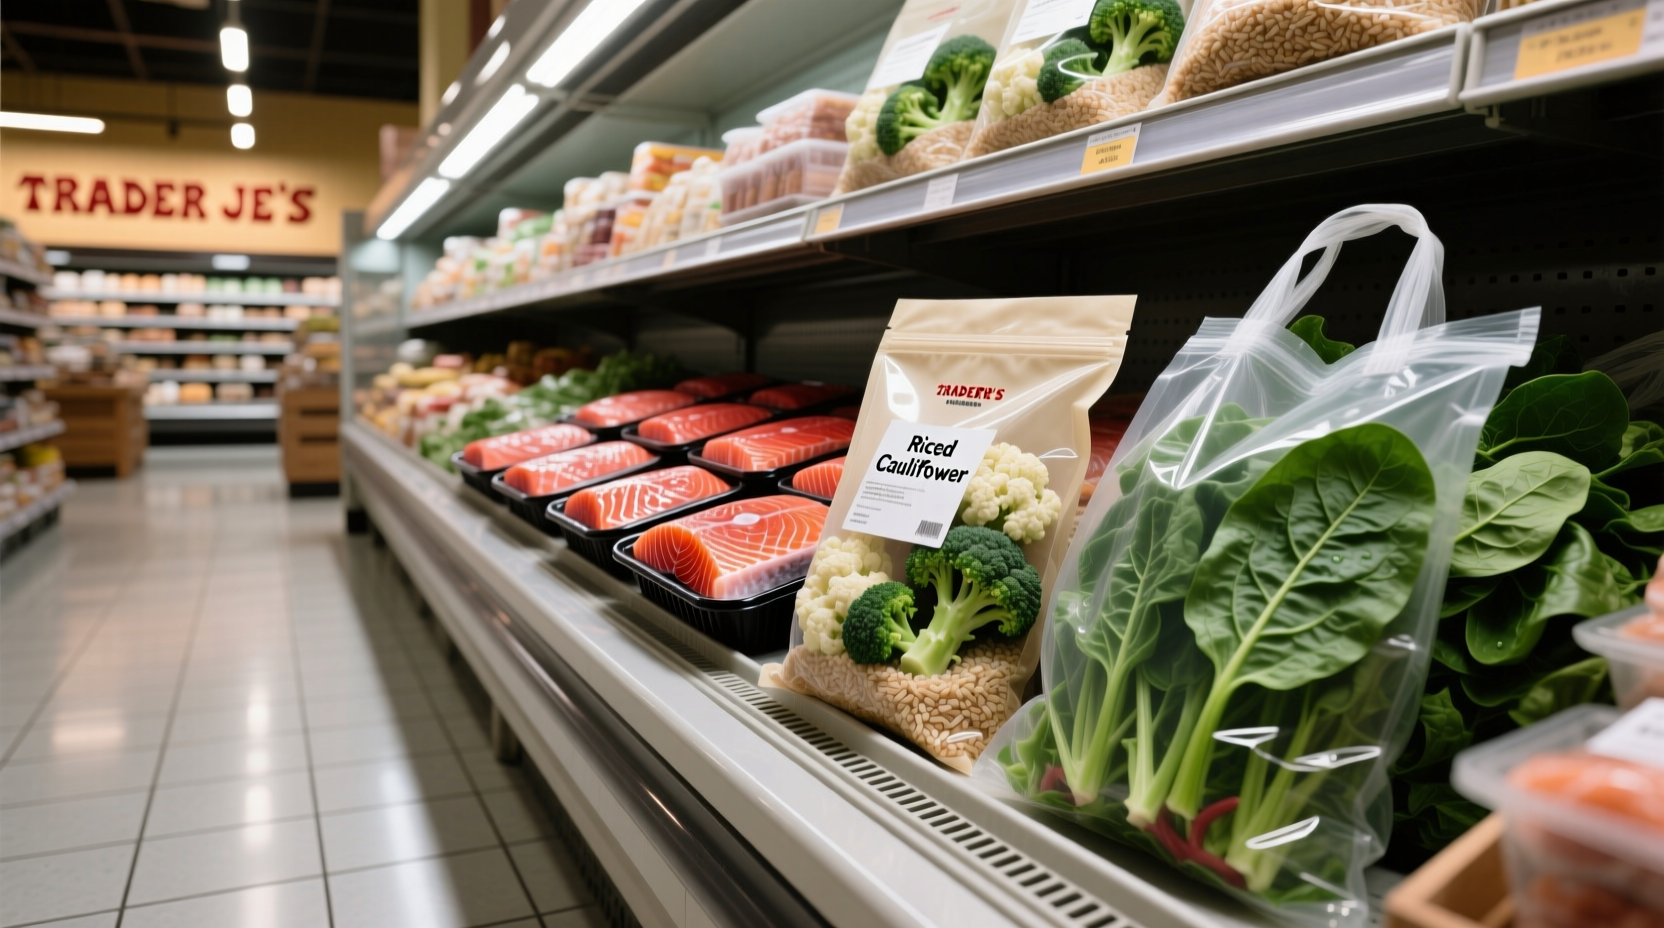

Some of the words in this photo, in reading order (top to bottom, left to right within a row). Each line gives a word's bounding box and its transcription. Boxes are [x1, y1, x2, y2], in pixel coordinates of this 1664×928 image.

[18, 175, 207, 219] TRADER
[223, 183, 317, 224] JE'S
[907, 434, 959, 457] Riced
